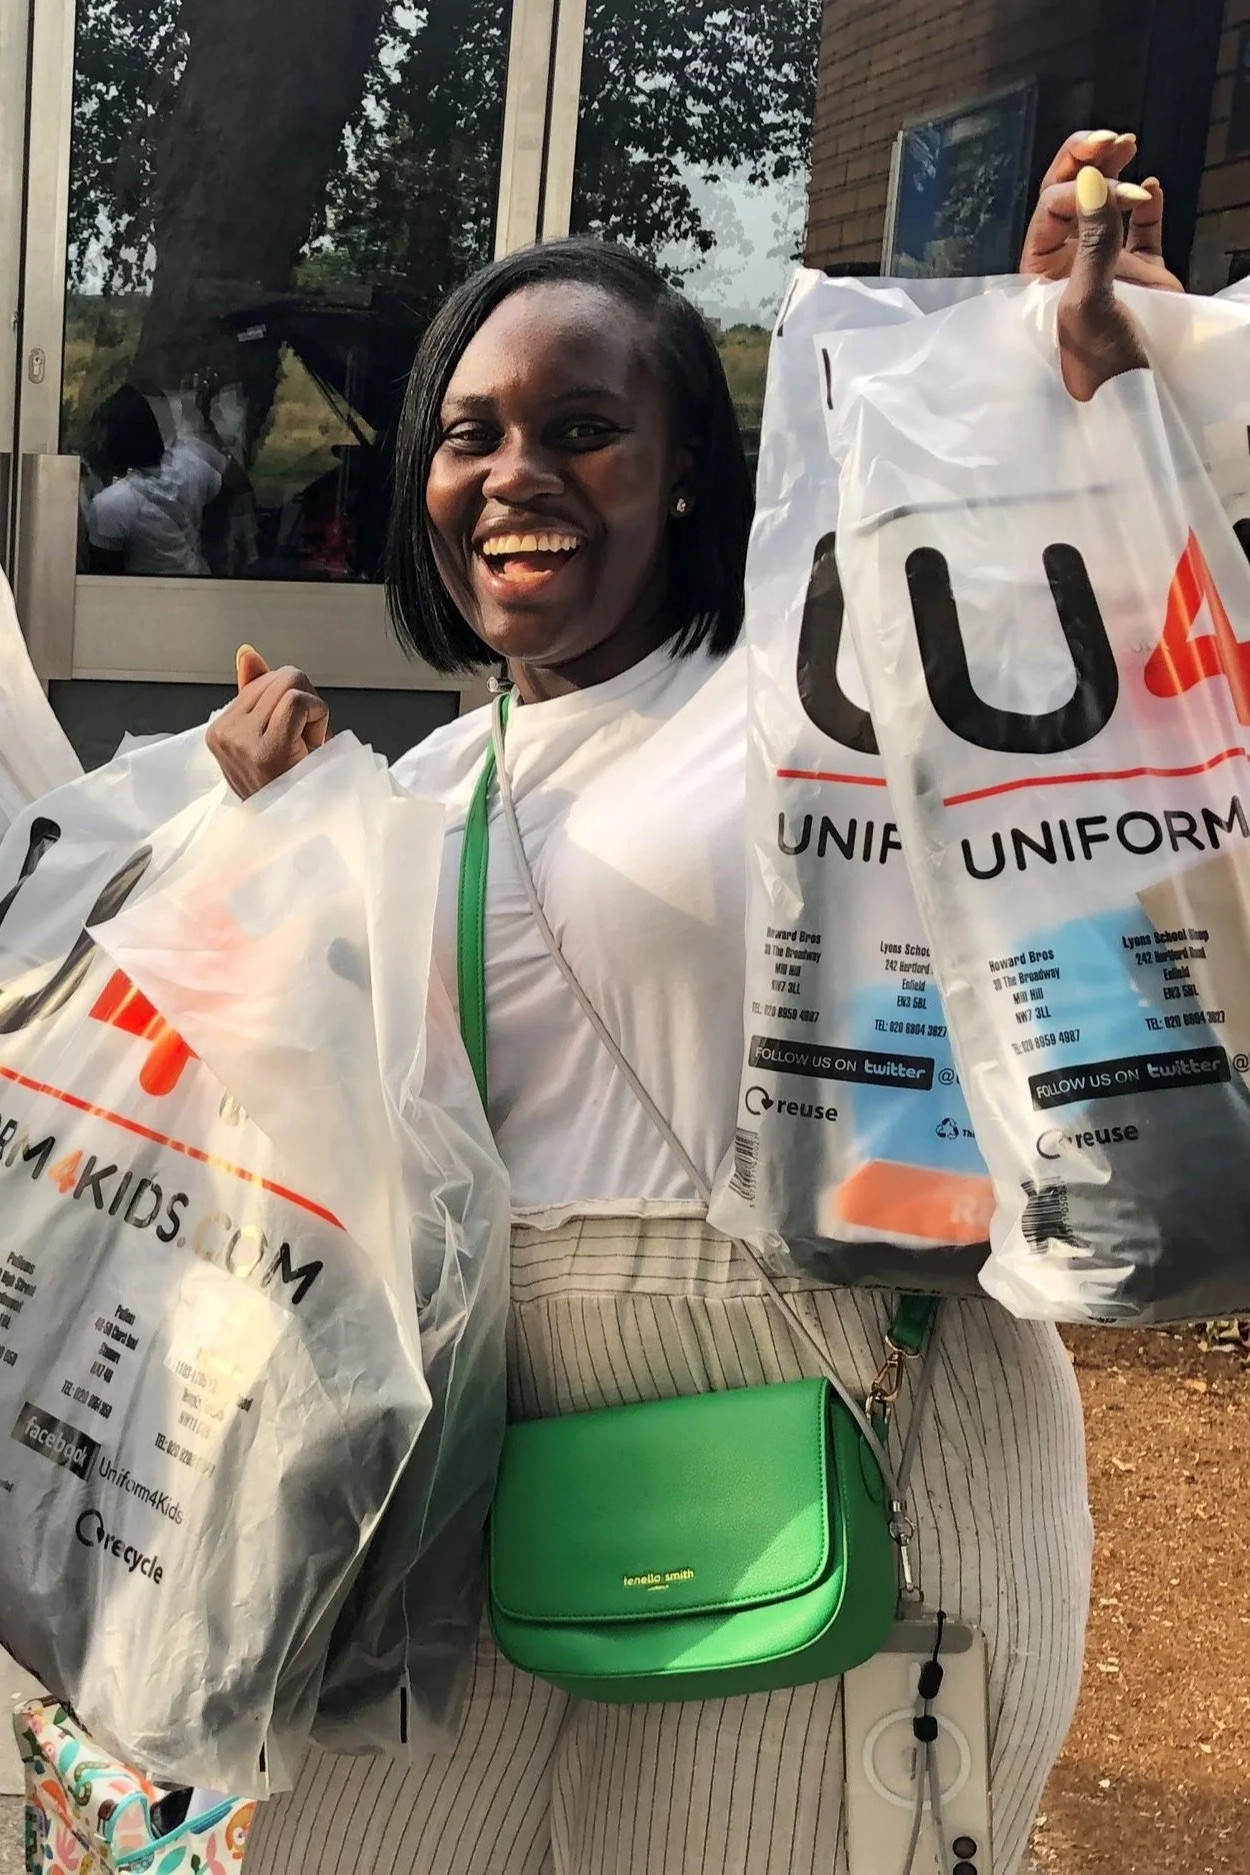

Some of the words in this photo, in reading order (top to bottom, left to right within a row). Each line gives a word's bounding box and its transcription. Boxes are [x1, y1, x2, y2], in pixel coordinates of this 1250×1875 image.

[800, 931, 821, 944] Bros
[1122, 932, 1152, 949] Lyons
[1154, 928, 1186, 943] School
[773, 945, 784, 957] The
[785, 947, 821, 963] Broadway
[880, 940, 902, 955] Lyons
[885, 959, 897, 972] 242
[988, 953, 1027, 973] Howard
[1029, 949, 1055, 963] Bros
[1135, 951, 1153, 965] 242
[902, 978, 925, 992] Enfield
[1003, 975, 1017, 988] The
[1019, 967, 1060, 985] Broadway
[897, 996, 911, 1008] EN3
[1013, 990, 1028, 1004] Mill
[1030, 987, 1044, 1001] Hill
[1015, 1010, 1033, 1024] NW7
[1035, 1008, 1051, 1020] 3LL
[1145, 1017, 1163, 1032] TEL:
[1164, 1015, 1181, 1029] 020
[875, 1019, 889, 1032] TEL:
[889, 1021, 903, 1033] 020
[905, 1023, 925, 1036] 8804
[1035, 1032, 1057, 1049] 8959
[1058, 1029, 1080, 1044] 4987
[755, 1046, 809, 1066] FOLLOW
[812, 1053, 831, 1068] US
[834, 1059, 857, 1072] ON
[864, 1059, 926, 1080] twitter
[1035, 1071, 1086, 1099] FOLLOW
[1089, 1073, 1111, 1088] US
[1115, 1067, 1140, 1084] ON
[1147, 1058, 1221, 1079] twitter
[777, 1098, 838, 1121] reuse
[1076, 1124, 1139, 1149] reuse
[61, 1380, 73, 1396] TEL:
[24, 1416, 88, 1468] facebook
[99, 1456, 183, 1525] Uniform4Kids
[104, 1532, 163, 1584] recycle
[665, 1569, 694, 1581] smith
